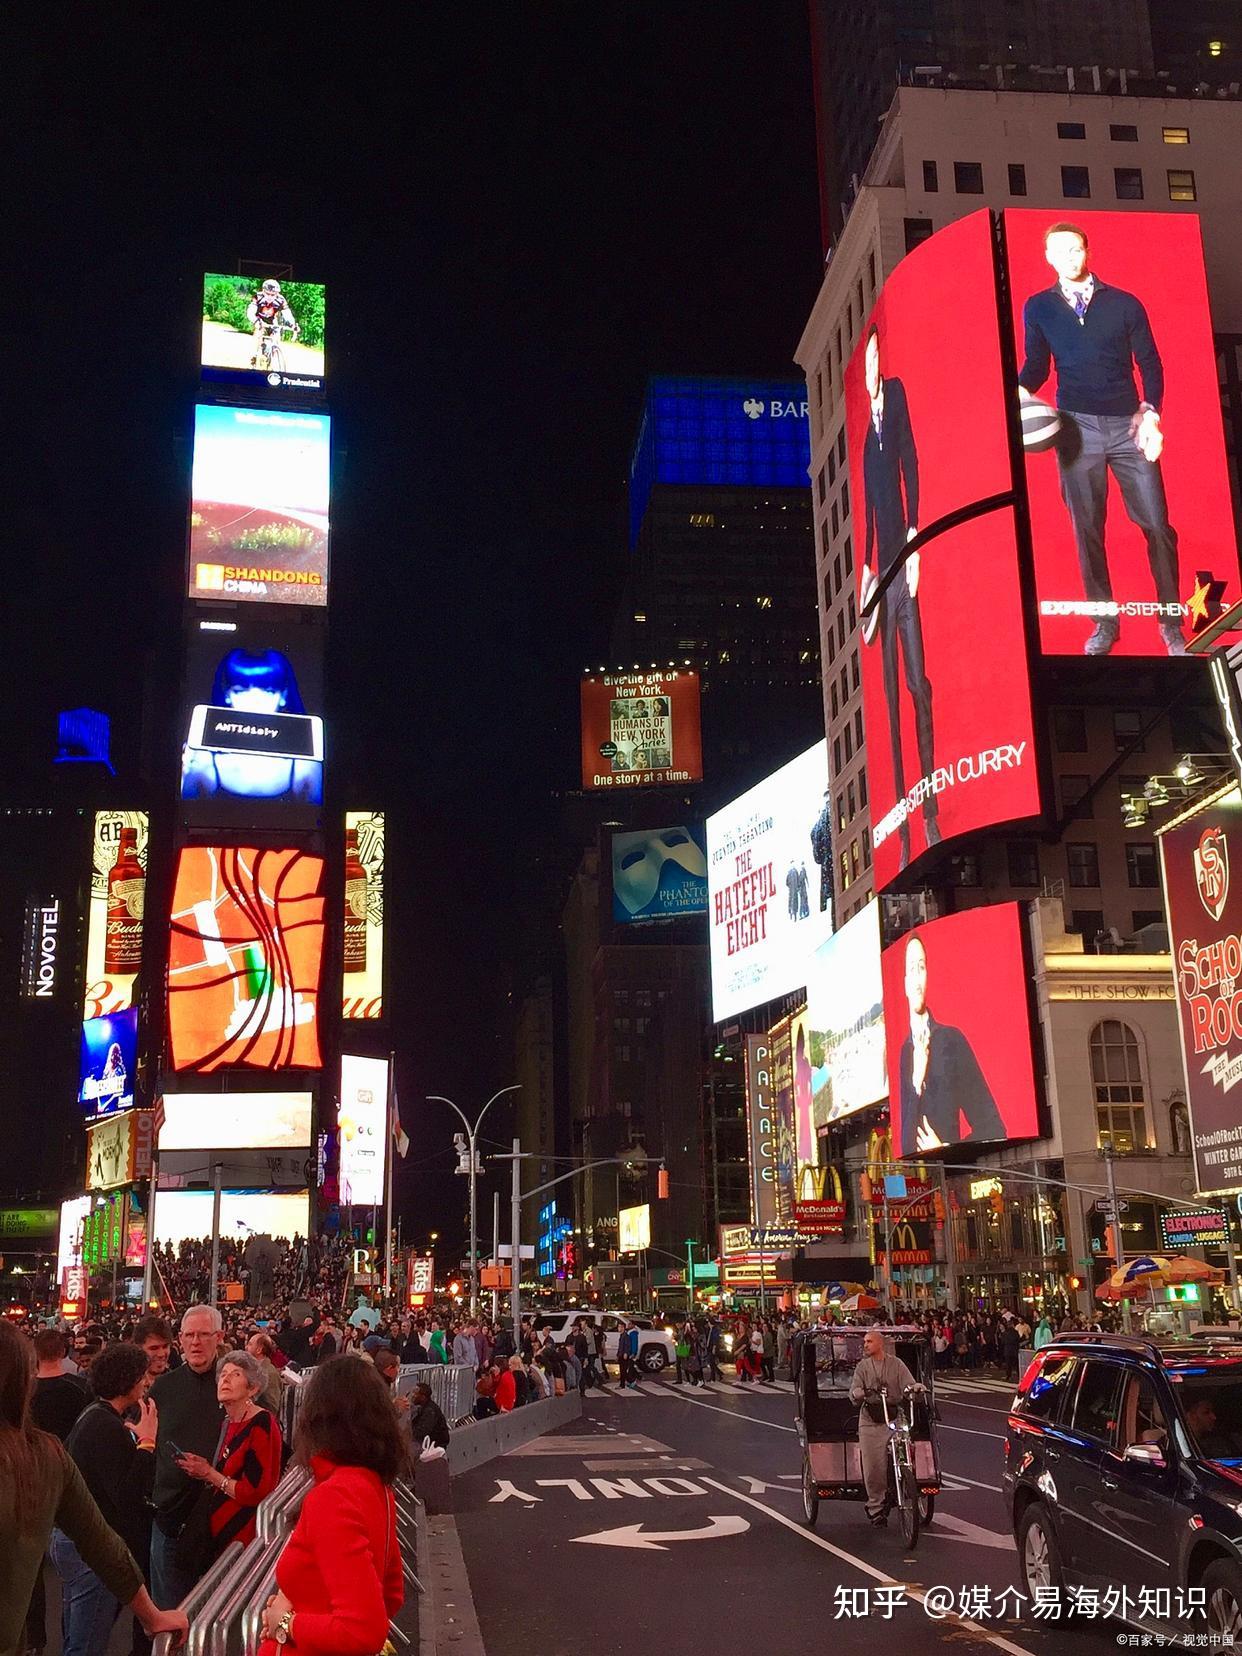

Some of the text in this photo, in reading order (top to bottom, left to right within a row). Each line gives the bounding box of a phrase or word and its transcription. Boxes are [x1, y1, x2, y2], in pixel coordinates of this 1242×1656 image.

[224, 567, 321, 585] SHANDONG
[224, 580, 268, 594] CHINA
[616, 684, 665, 697] New York.
[613, 718, 665, 731] HUMANS OF
[613, 729, 666, 742] NEW YORK
[957, 742, 1027, 783] CURRY
[594, 771, 692, 786] One story at a time.
[735, 848, 753, 877] THE
[714, 861, 777, 926] HATEFUL
[726, 903, 768, 956] EIGHT
[36, 899, 59, 996] NOVOTEL
[1179, 935, 1242, 1001] SCHO
[1072, 984, 1100, 998] THE
[1106, 984, 1149, 998] SHOW
[1220, 979, 1235, 998] OF
[1215, 1060, 1225, 1075] THE
[756, 1047, 774, 1182] PALACE
[1204, 1149, 1229, 1165] WINTER
[597, 1217, 618, 1227] ANG
[1165, 1215, 1224, 1232] ELECTRONICS
